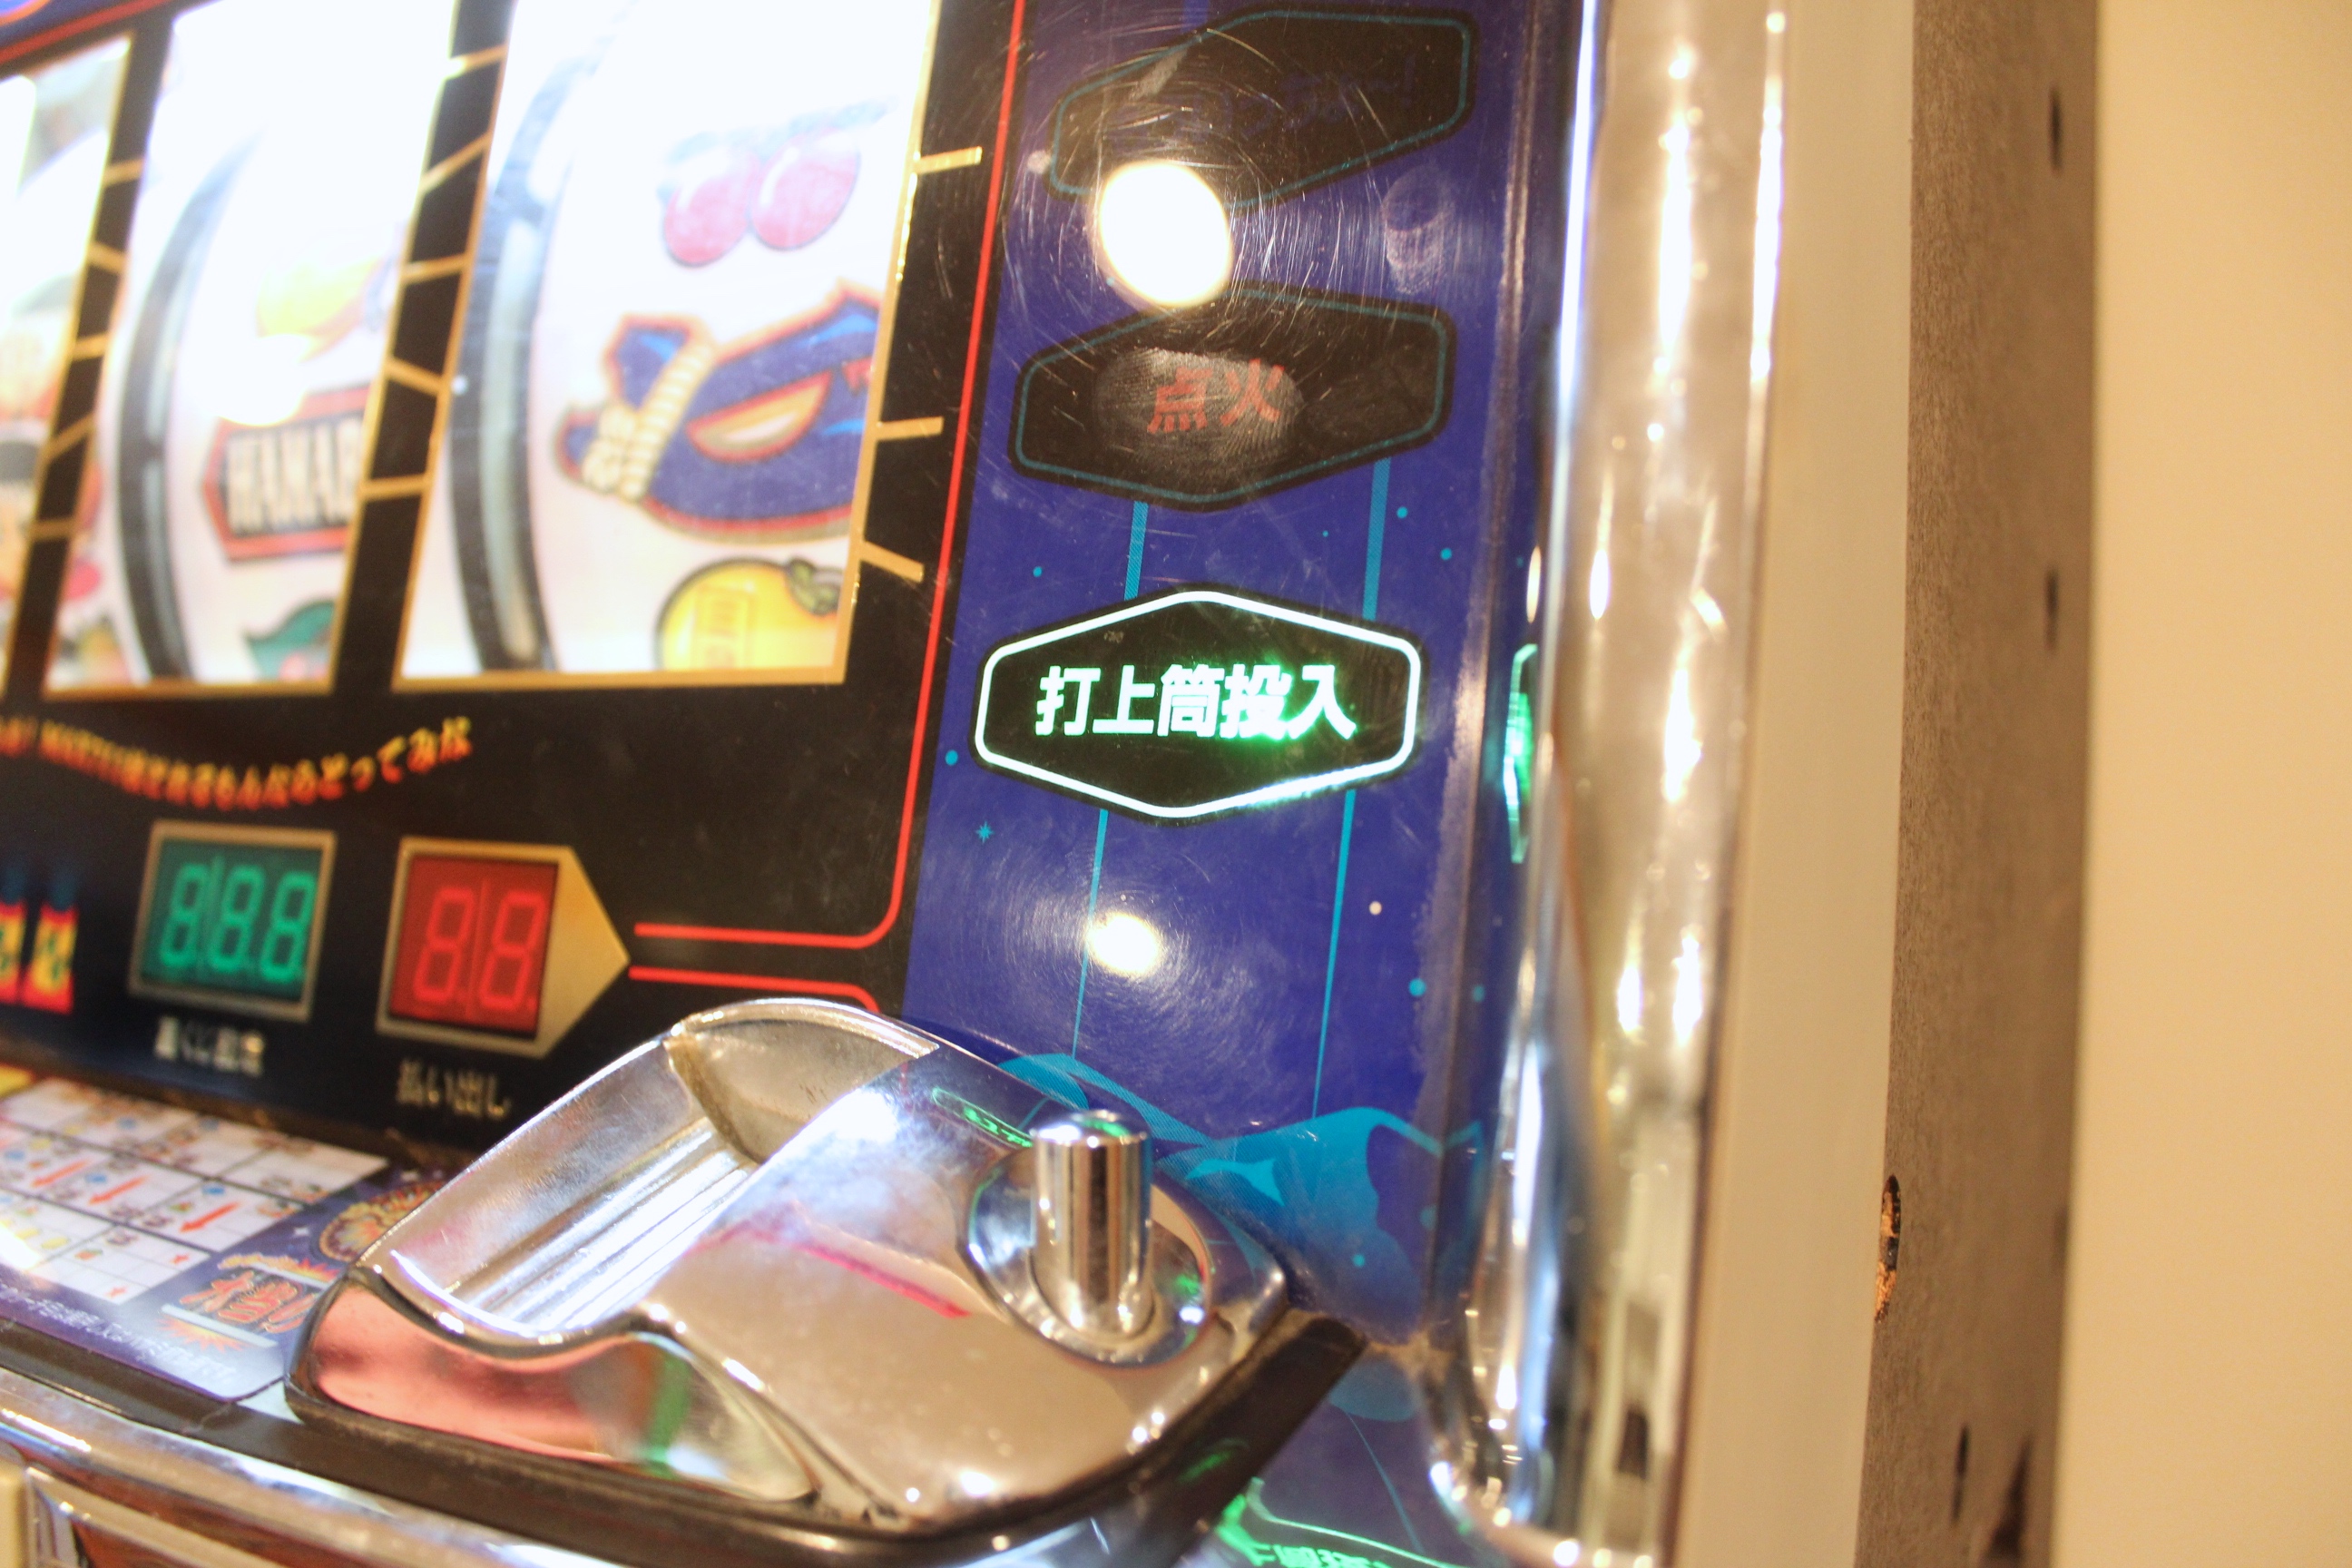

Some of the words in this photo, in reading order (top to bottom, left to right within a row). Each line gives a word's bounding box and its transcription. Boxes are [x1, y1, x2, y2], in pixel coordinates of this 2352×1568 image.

[1148, 358, 1286, 435] 点火
[1034, 663, 1357, 741] 打上筒投入
